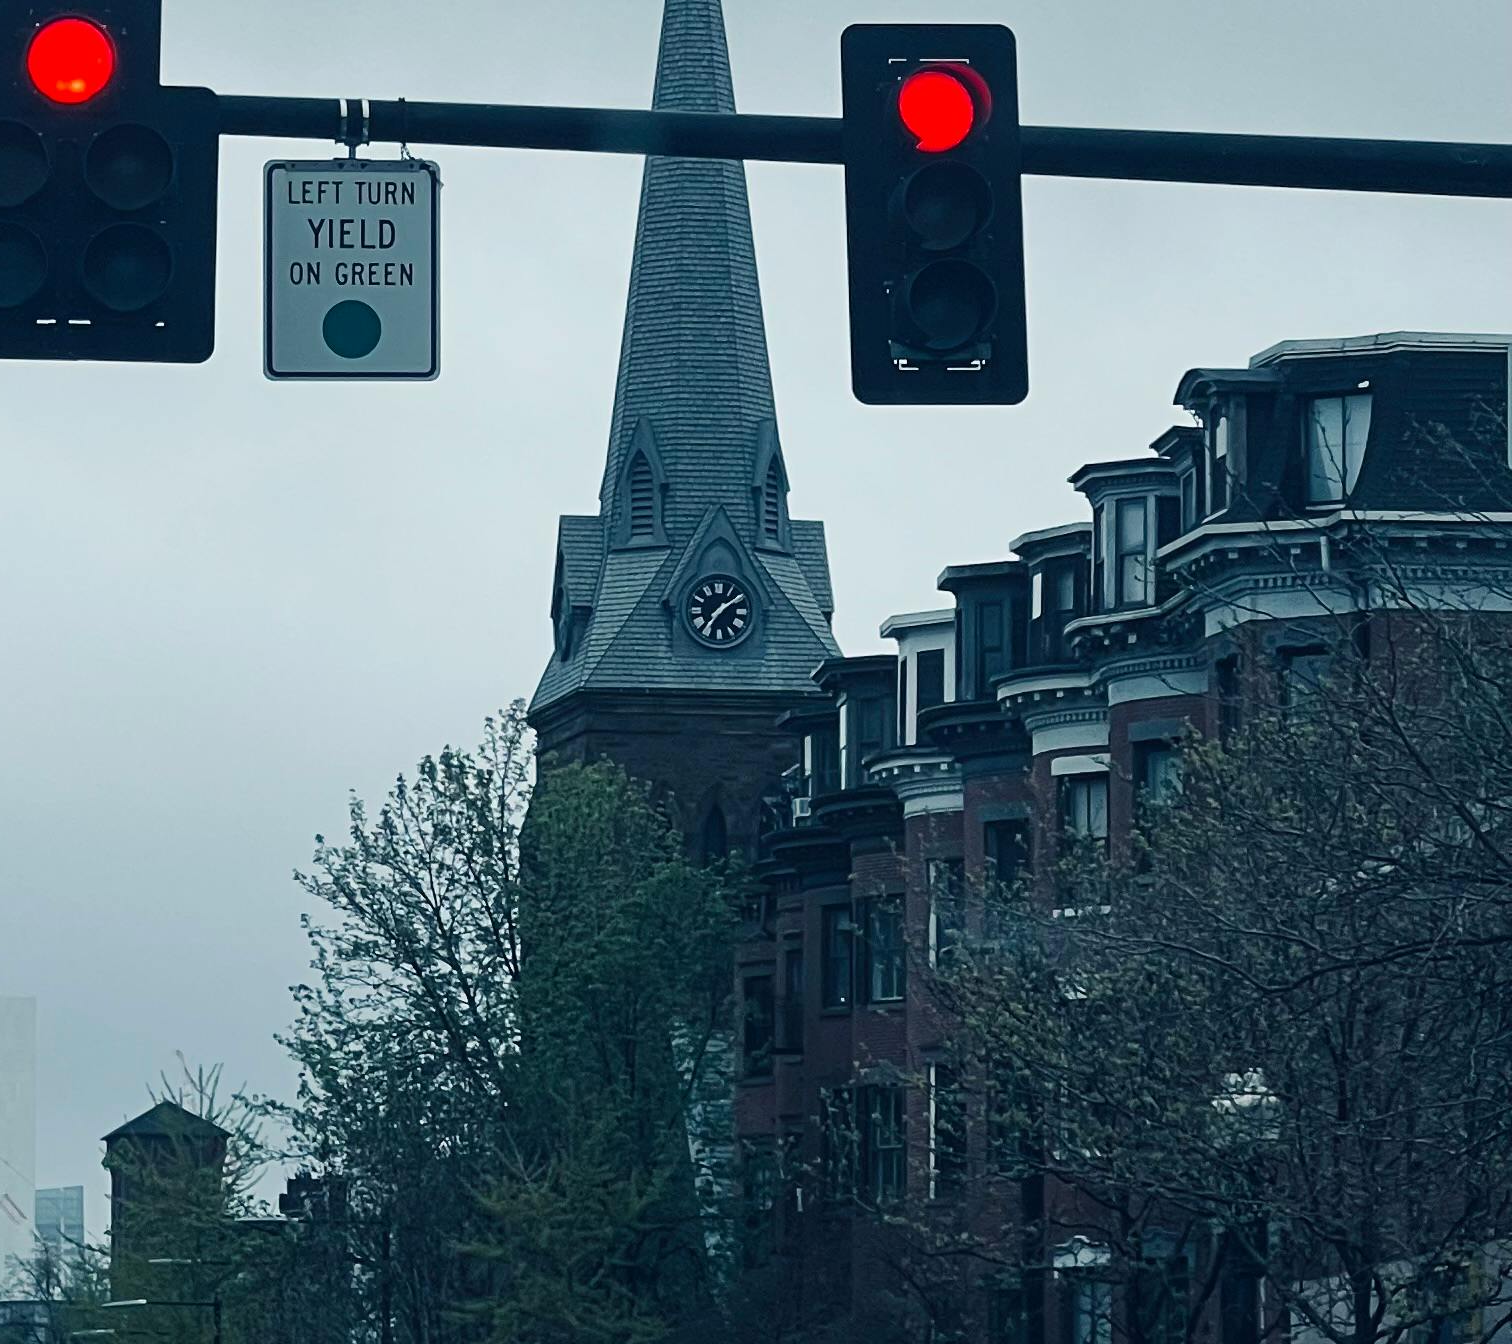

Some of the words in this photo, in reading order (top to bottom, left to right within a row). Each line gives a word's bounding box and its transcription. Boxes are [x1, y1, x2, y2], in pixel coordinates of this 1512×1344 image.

[288, 181, 343, 204] LEFT
[355, 181, 415, 204] TURN
[308, 218, 396, 249] YIELD
[290, 261, 320, 285] ON
[335, 262, 413, 286] GREEN
